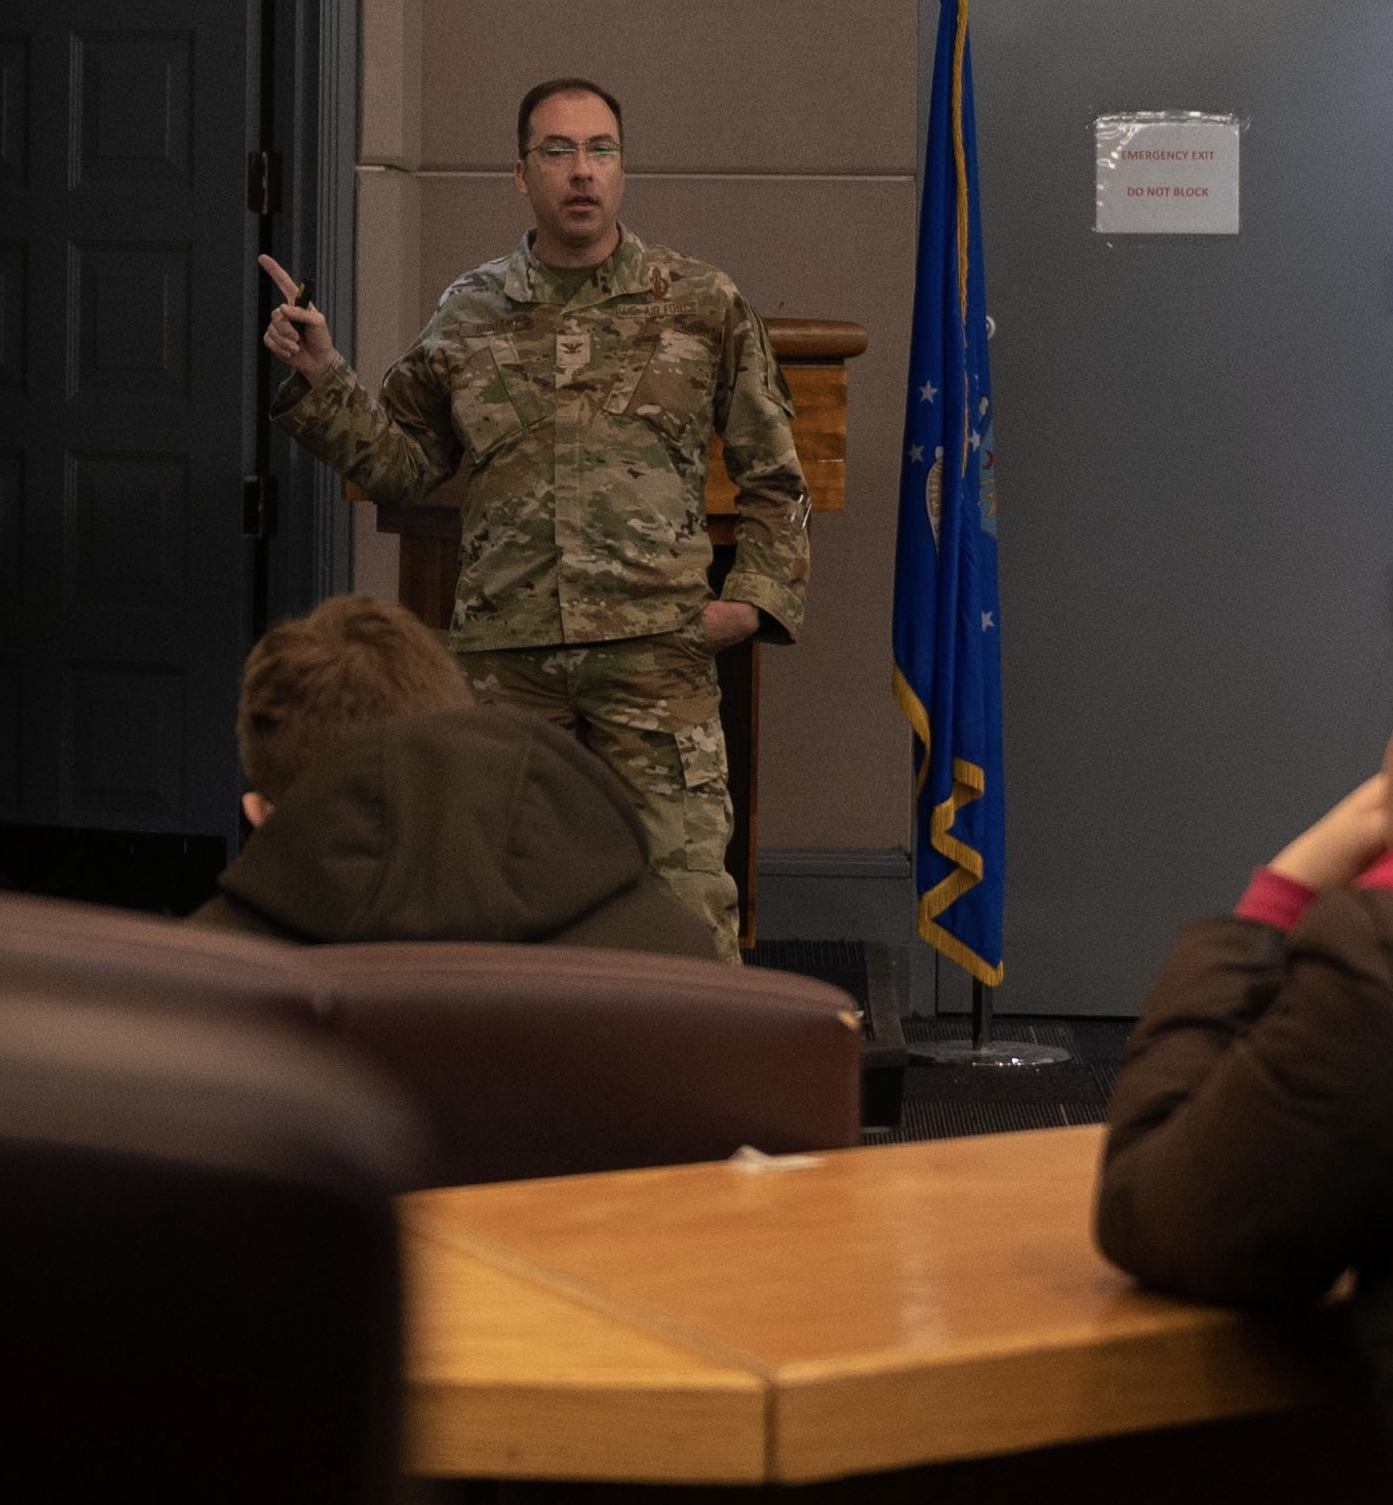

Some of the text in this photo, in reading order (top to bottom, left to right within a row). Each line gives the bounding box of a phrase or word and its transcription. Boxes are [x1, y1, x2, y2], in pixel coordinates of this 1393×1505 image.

[1121, 150, 1214, 160] EMERGENCY EXIT
[1127, 187, 1208, 197] DO NOT BLOCK
